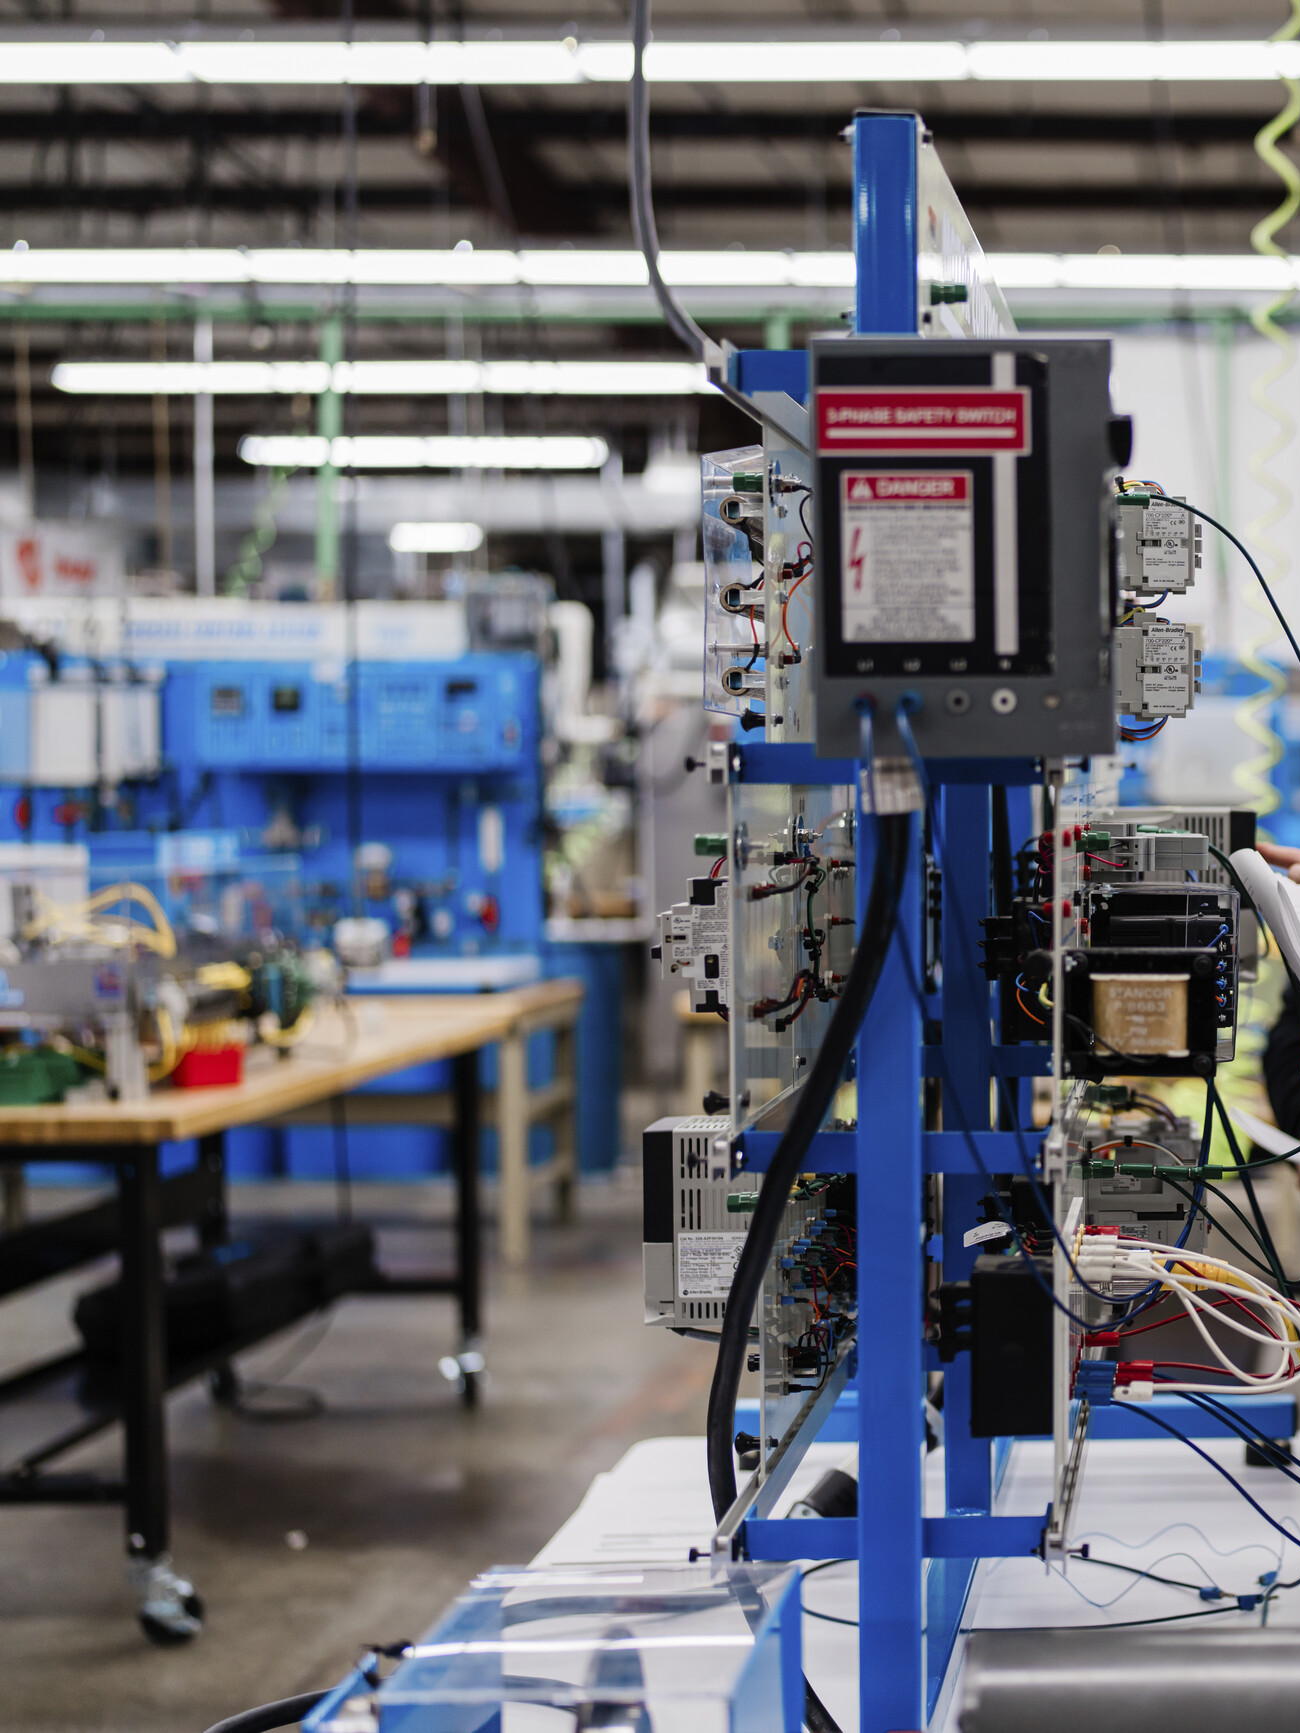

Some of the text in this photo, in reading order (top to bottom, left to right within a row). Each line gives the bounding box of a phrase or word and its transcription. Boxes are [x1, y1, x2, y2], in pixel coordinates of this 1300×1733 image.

[826, 407, 1017, 425] 3-PHASE SAFETY SWITCH
[875, 479, 956, 498] DANGER
[1109, 987, 1172, 998] STANCOR
